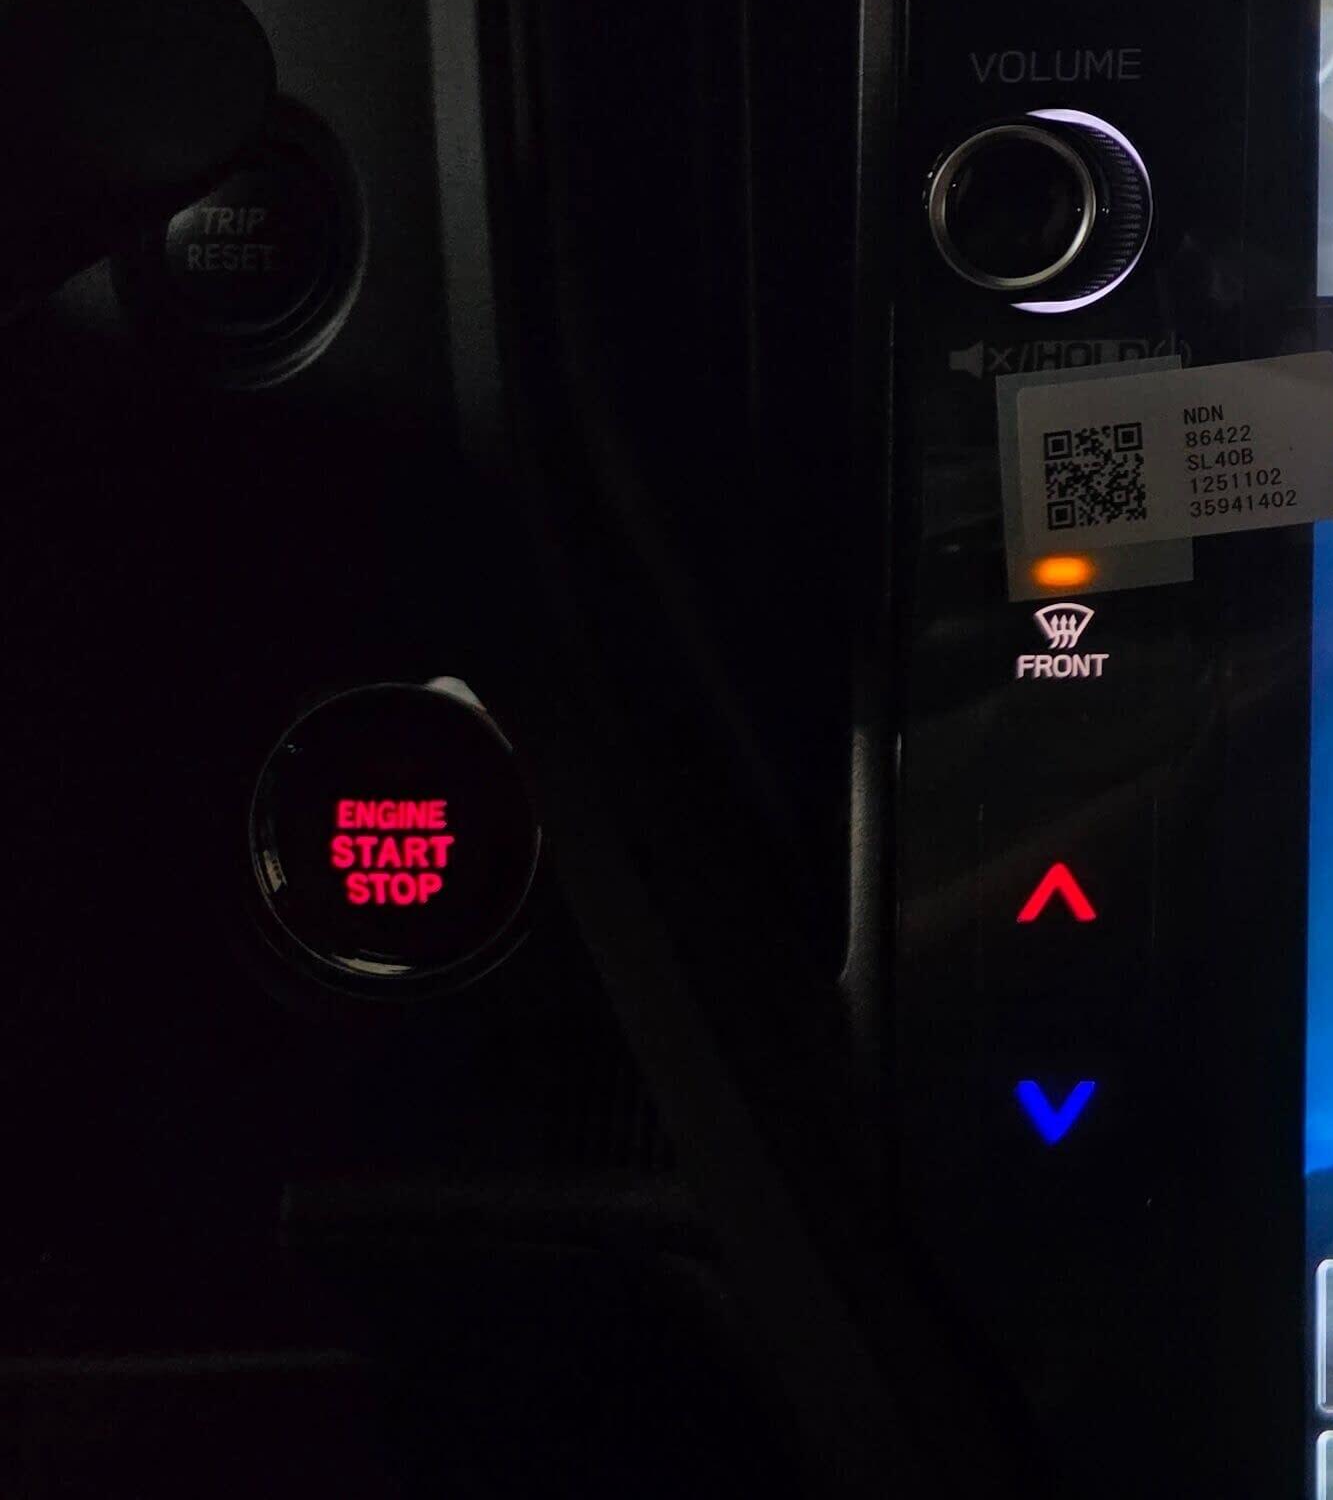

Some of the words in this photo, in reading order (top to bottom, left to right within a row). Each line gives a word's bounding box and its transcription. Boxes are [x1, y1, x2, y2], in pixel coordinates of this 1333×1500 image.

[968, 48, 1142, 83] VOLUME
[200, 206, 268, 236] TRIP
[187, 243, 278, 272] RESET
[1183, 404, 1224, 425] NDN
[1185, 425, 1252, 447] 86422
[1187, 448, 1254, 471] SL40B
[1191, 468, 1282, 494] 1251102
[1190, 490, 1298, 518] 35941402
[1016, 653, 1110, 679] FRONT
[336, 800, 447, 830] ENGINE
[331, 835, 454, 868] START
[346, 872, 443, 905] STOP
